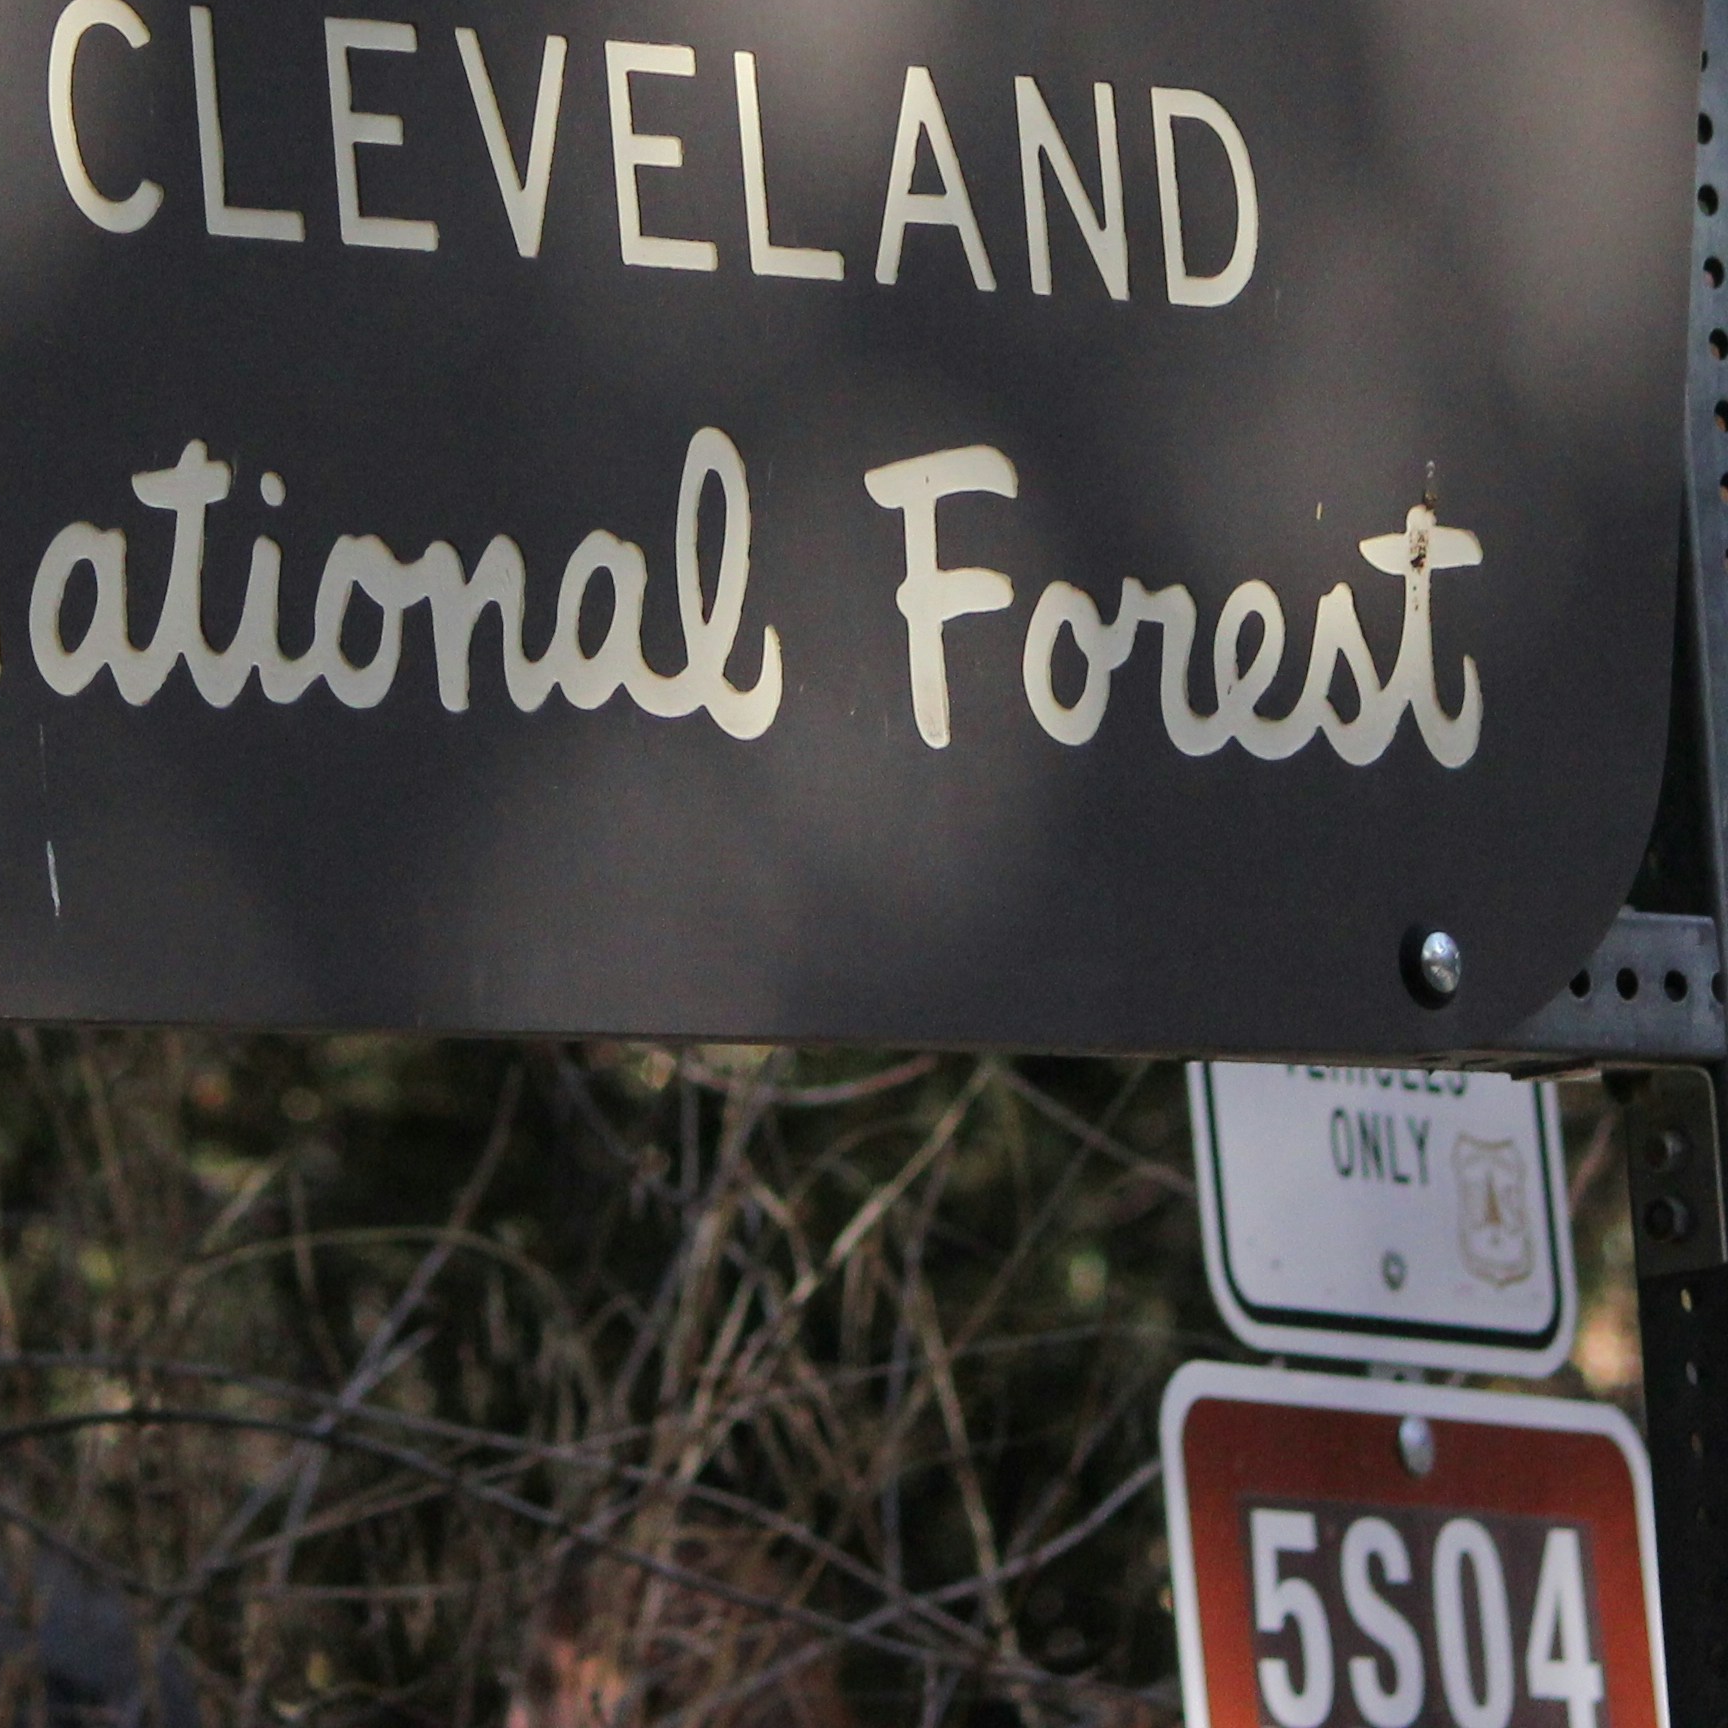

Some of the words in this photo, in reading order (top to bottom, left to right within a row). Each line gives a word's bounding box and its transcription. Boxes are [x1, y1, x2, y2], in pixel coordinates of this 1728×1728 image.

[865, 444, 1484, 768] Forest
[1330, 1106, 1430, 1185] ONLY
[1249, 1507, 1605, 1728] 5S04
